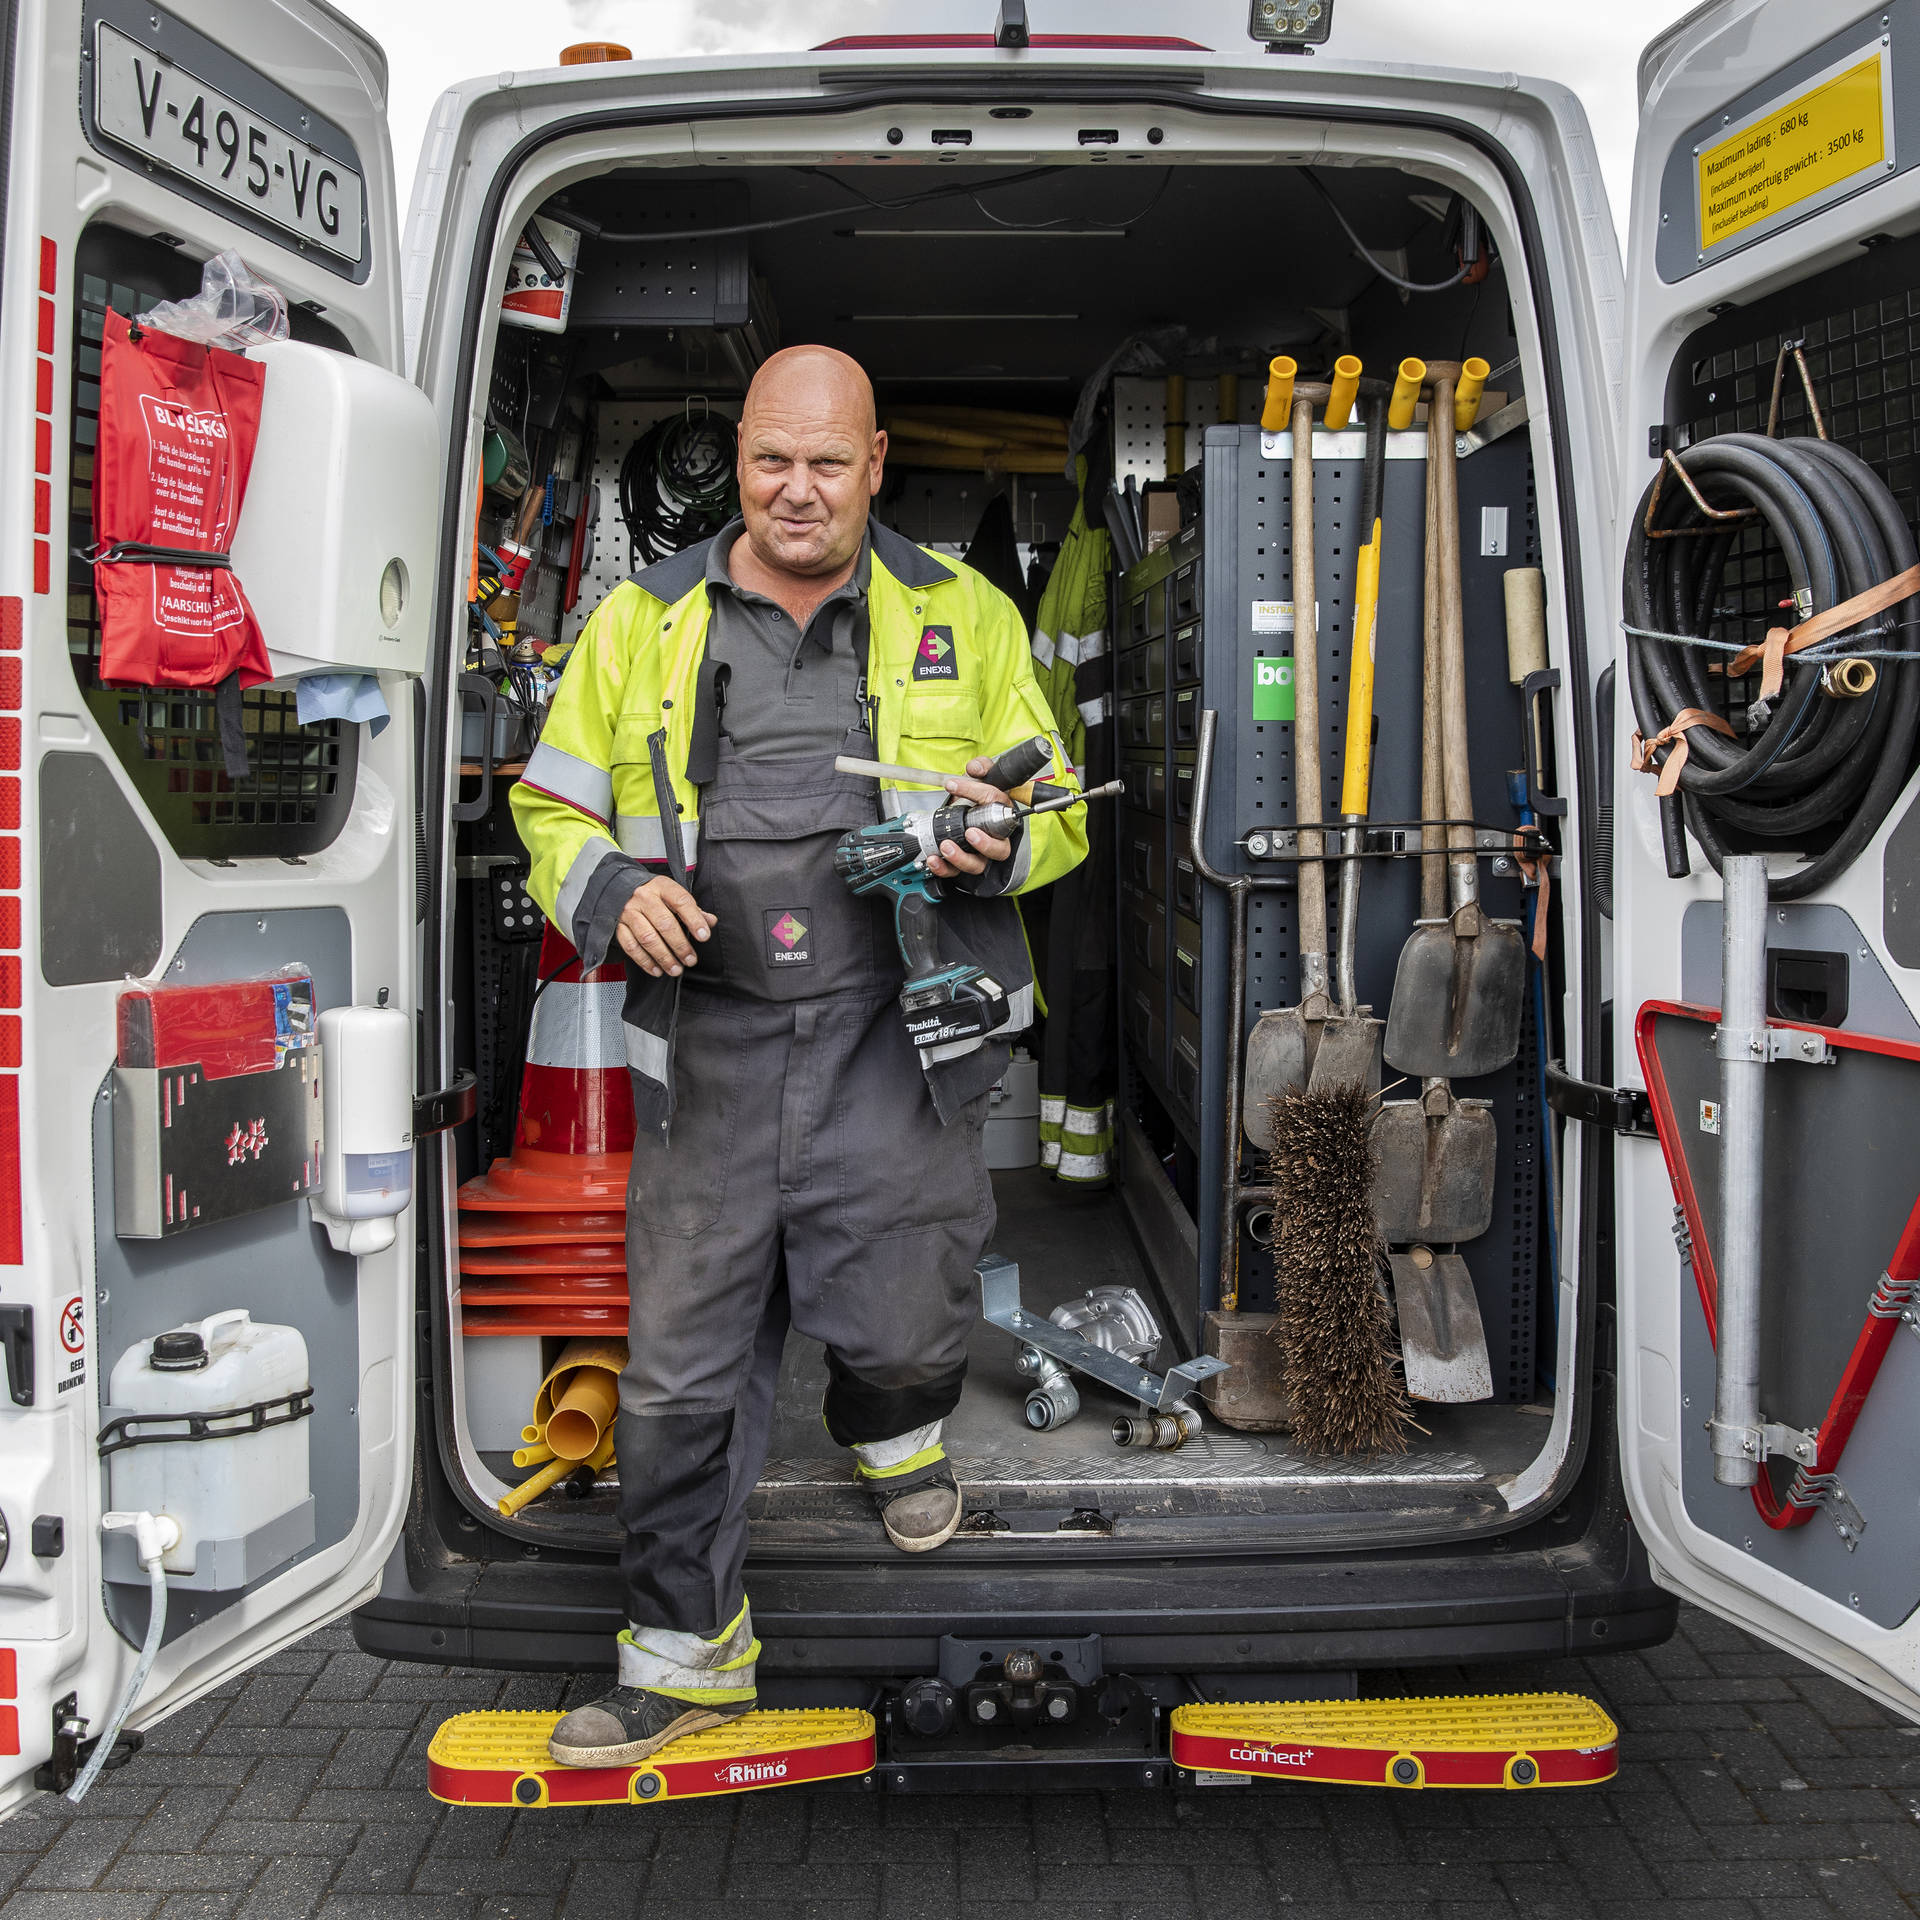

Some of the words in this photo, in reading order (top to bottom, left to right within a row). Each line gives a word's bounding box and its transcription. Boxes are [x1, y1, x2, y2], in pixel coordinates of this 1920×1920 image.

[133, 57, 340, 236] V-495-VG
[1707, 148, 1745, 176] Maximum
[1746, 133, 1771, 155] lading
[1780, 117, 1797, 136] 680
[1798, 112, 1809, 127] kg
[1708, 189, 1747, 217] Maximum
[1748, 170, 1782, 196] voertuig
[1783, 151, 1818, 181] gewicht
[1827, 133, 1850, 156] 3500
[1852, 128, 1864, 143] kg
[1739, 195, 1769, 218] belading)
[919, 665, 952, 675] ENEXIS
[1257, 662, 1294, 685] bo
[774, 951, 808, 961] ENEXIS
[57, 1372, 86, 1394] DRINKW
[729, 1764, 788, 1784] Rhino
